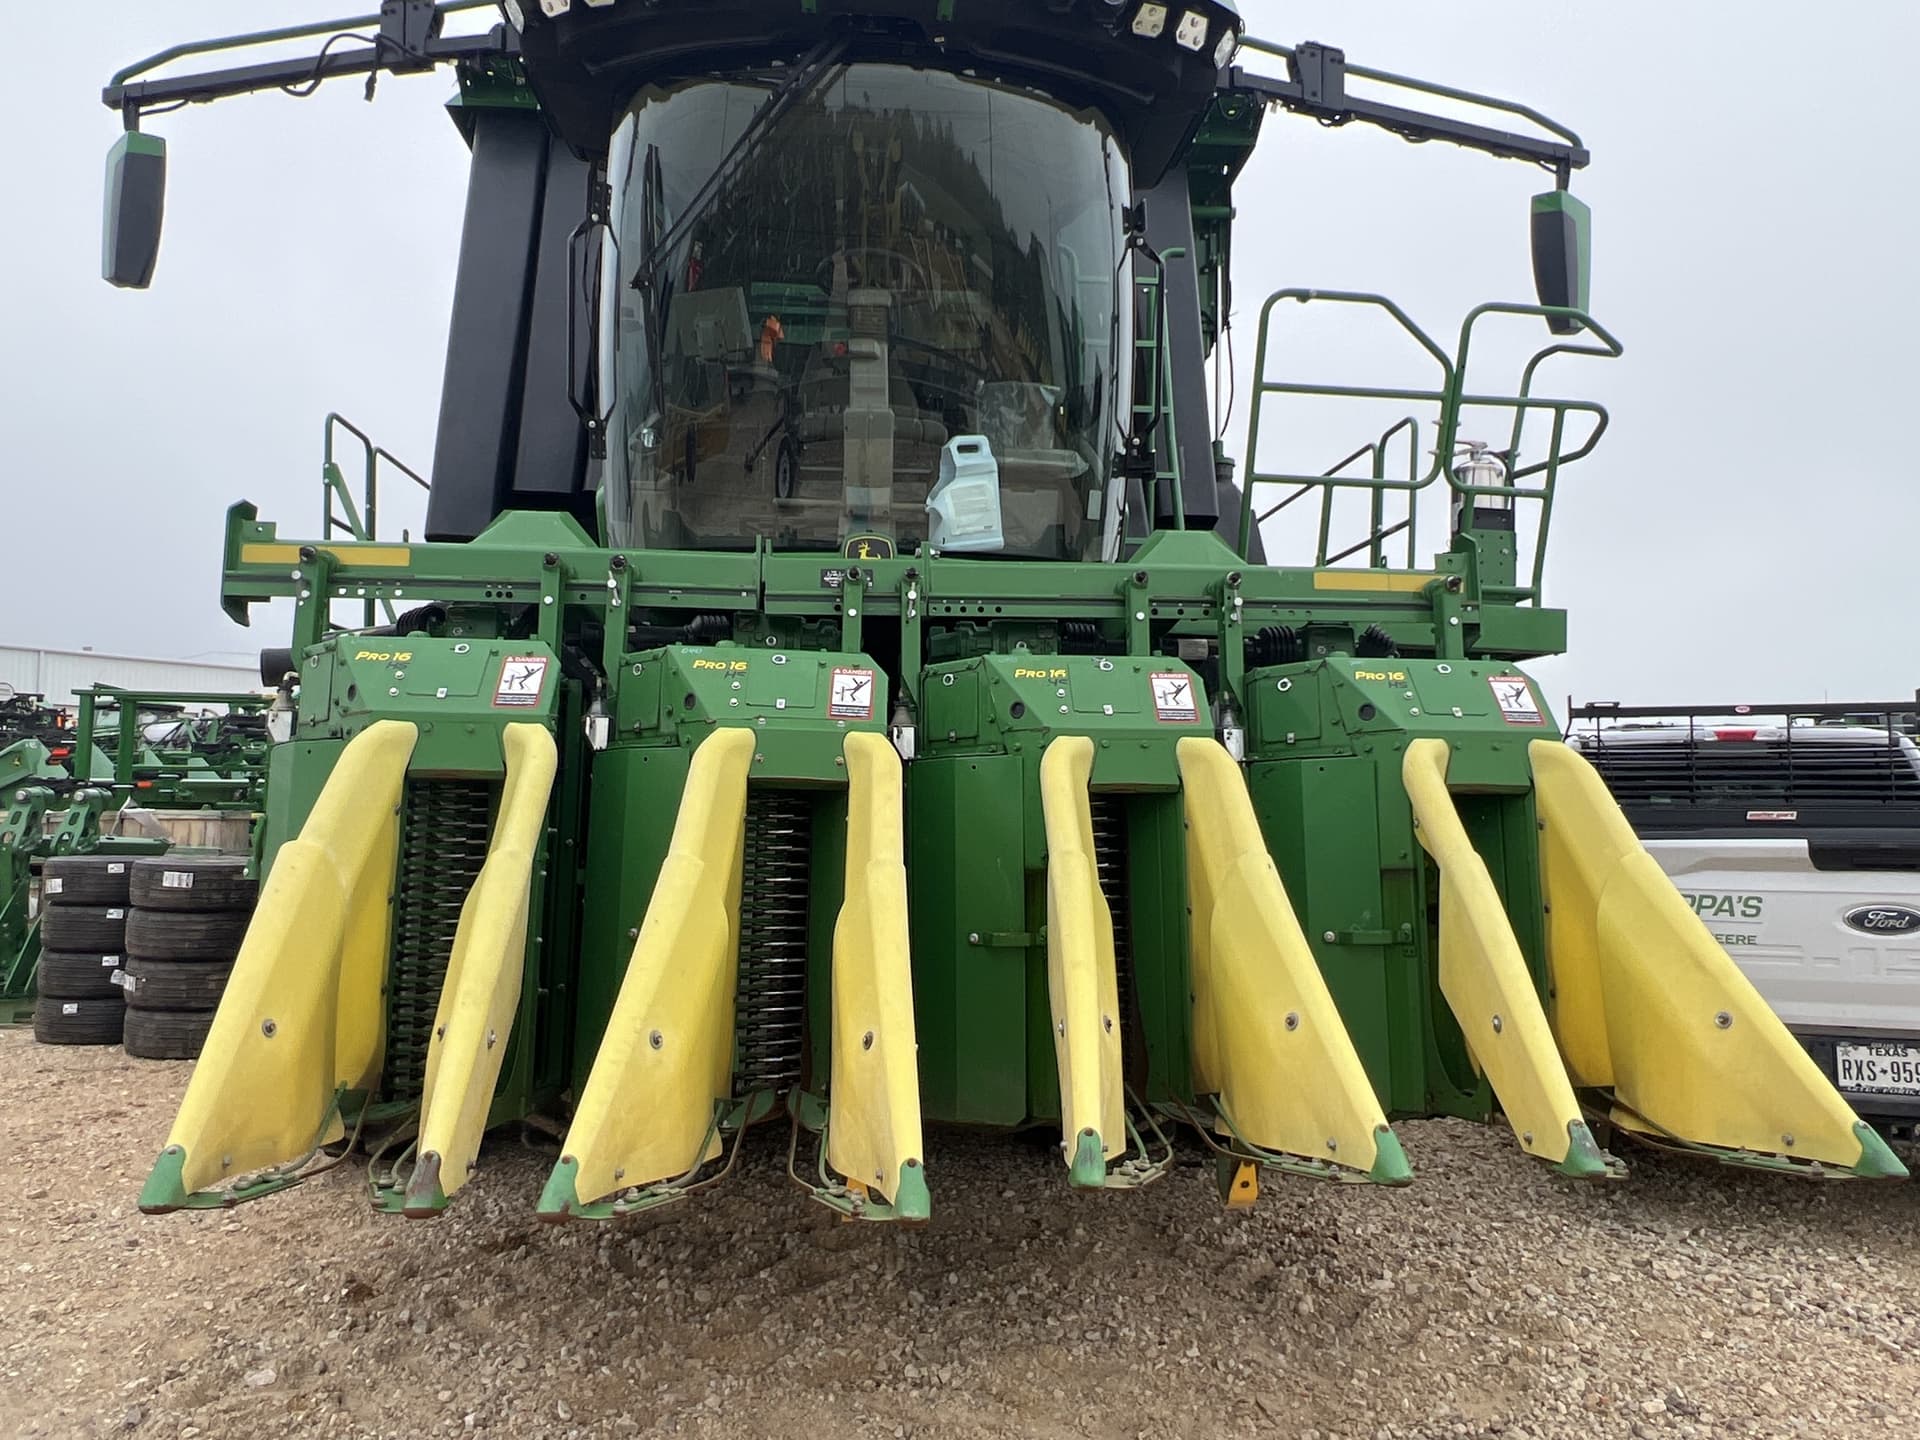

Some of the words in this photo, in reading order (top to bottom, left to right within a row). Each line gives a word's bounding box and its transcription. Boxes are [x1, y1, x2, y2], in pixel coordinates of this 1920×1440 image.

[393, 652, 412, 662] 16
[729, 661, 748, 671] 16
[1049, 669, 1067, 678] 16
[1387, 671, 1405, 681] 16
[1864, 910, 1910, 928] Ford
[1869, 1046, 1908, 1057] TEXAS
